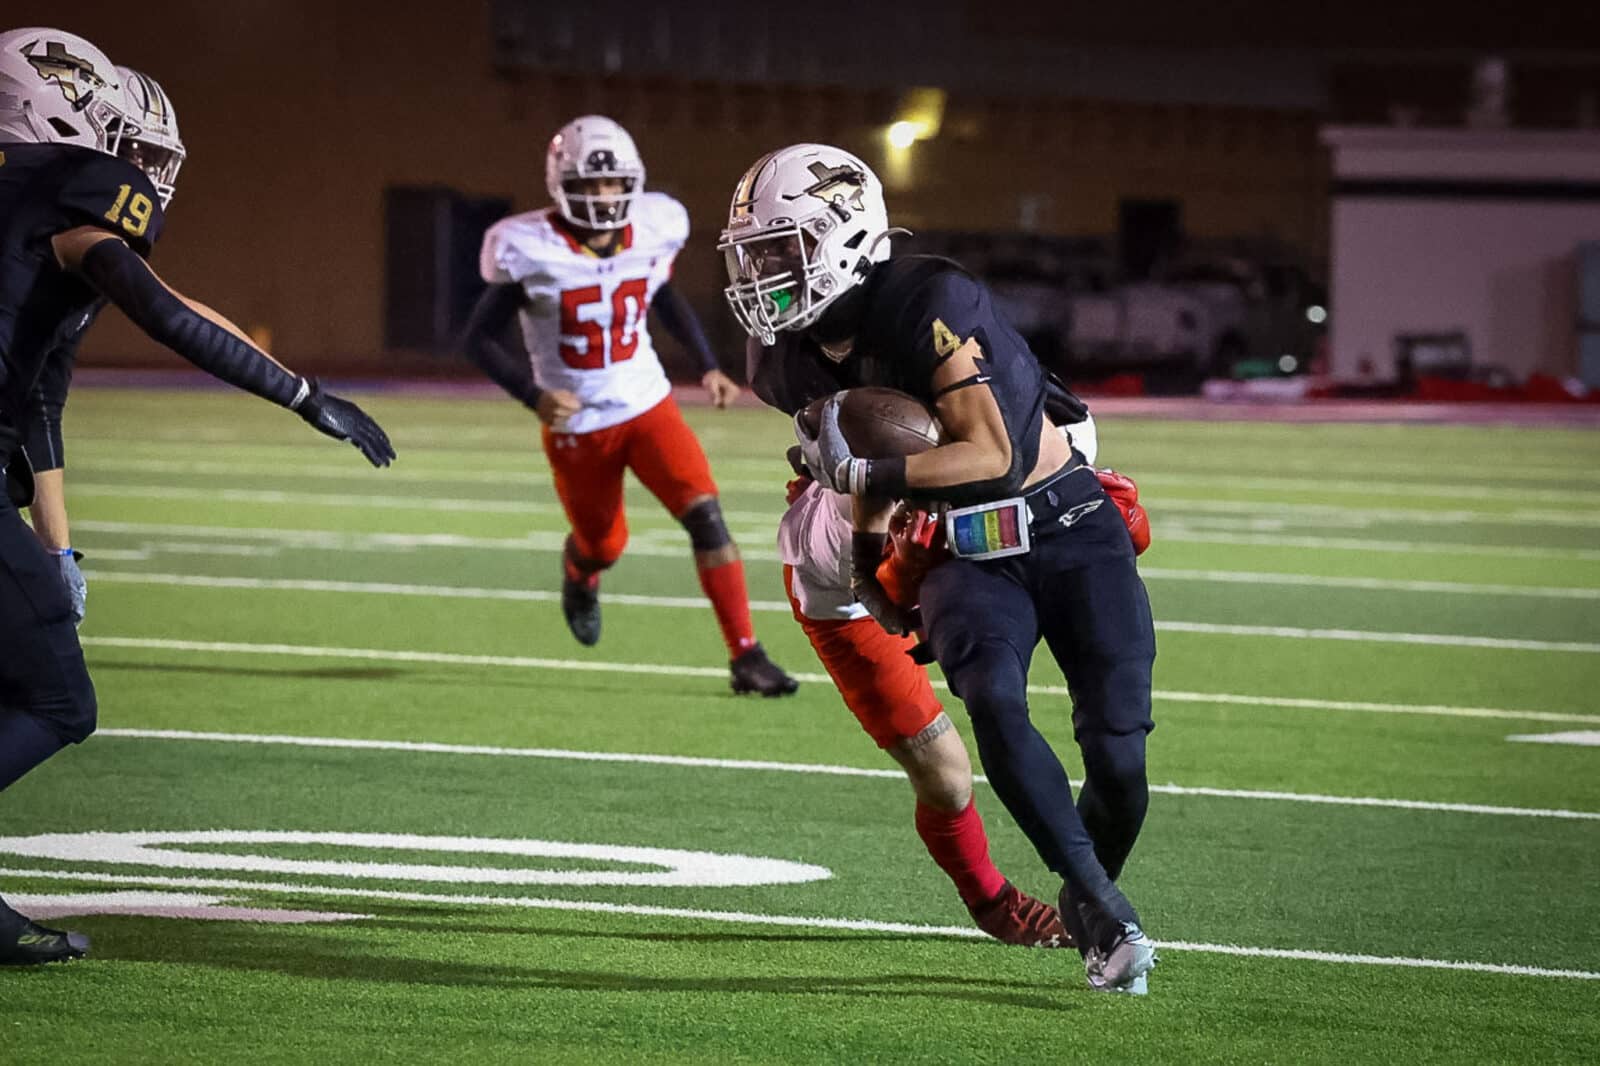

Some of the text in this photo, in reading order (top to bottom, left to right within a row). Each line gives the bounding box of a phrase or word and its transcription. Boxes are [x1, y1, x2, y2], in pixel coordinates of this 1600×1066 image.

[104, 184, 153, 236] 19
[559, 278, 648, 370] 50
[932, 318, 963, 357] 4
